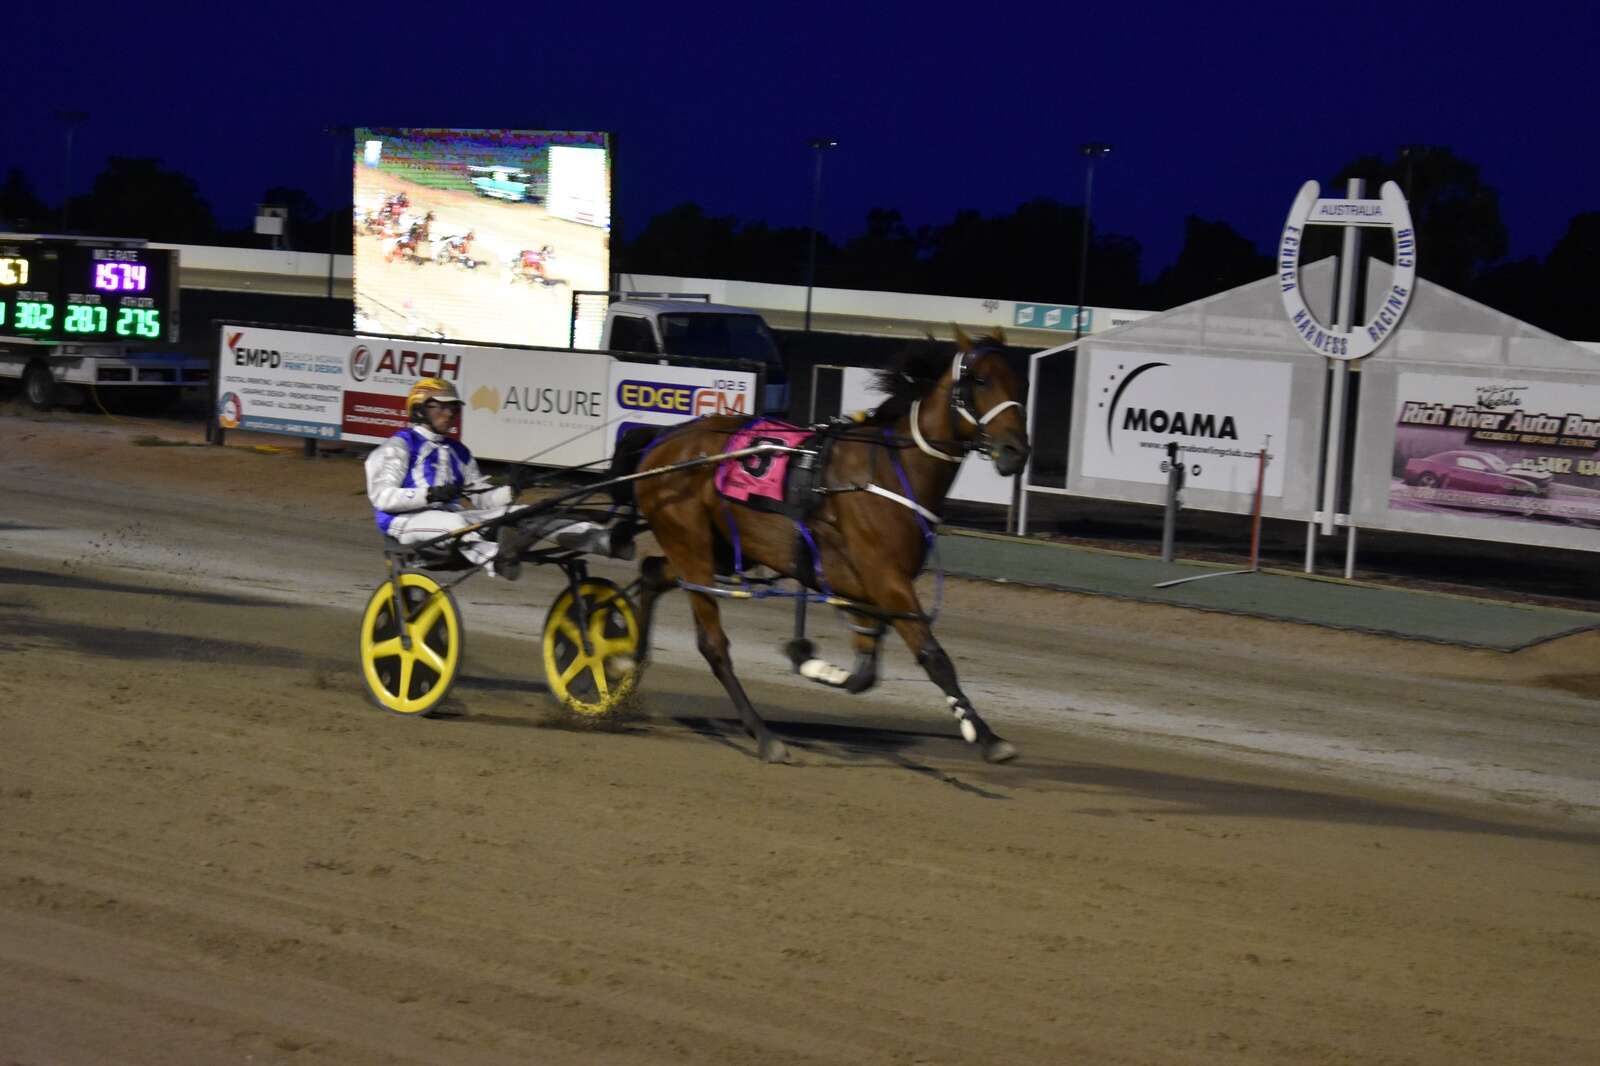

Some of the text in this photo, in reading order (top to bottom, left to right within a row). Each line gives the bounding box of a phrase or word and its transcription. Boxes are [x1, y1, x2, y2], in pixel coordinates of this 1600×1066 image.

[1320, 204, 1383, 217] AUSTRALIA
[1397, 228, 1413, 268] CLUB
[1367, 285, 1408, 343] RACING
[1294, 309, 1348, 355] HARNESS
[235, 348, 281, 369] EMPD
[375, 349, 462, 381] ARCH
[621, 384, 746, 416] EDGE FM
[713, 379, 747, 391] 102.5
[503, 386, 602, 417] AUSURE
[1122, 407, 1239, 440] MOAMA
[1401, 402, 1446, 426] Rich
[1449, 406, 1505, 430] River
[1505, 412, 1561, 435] Auto
